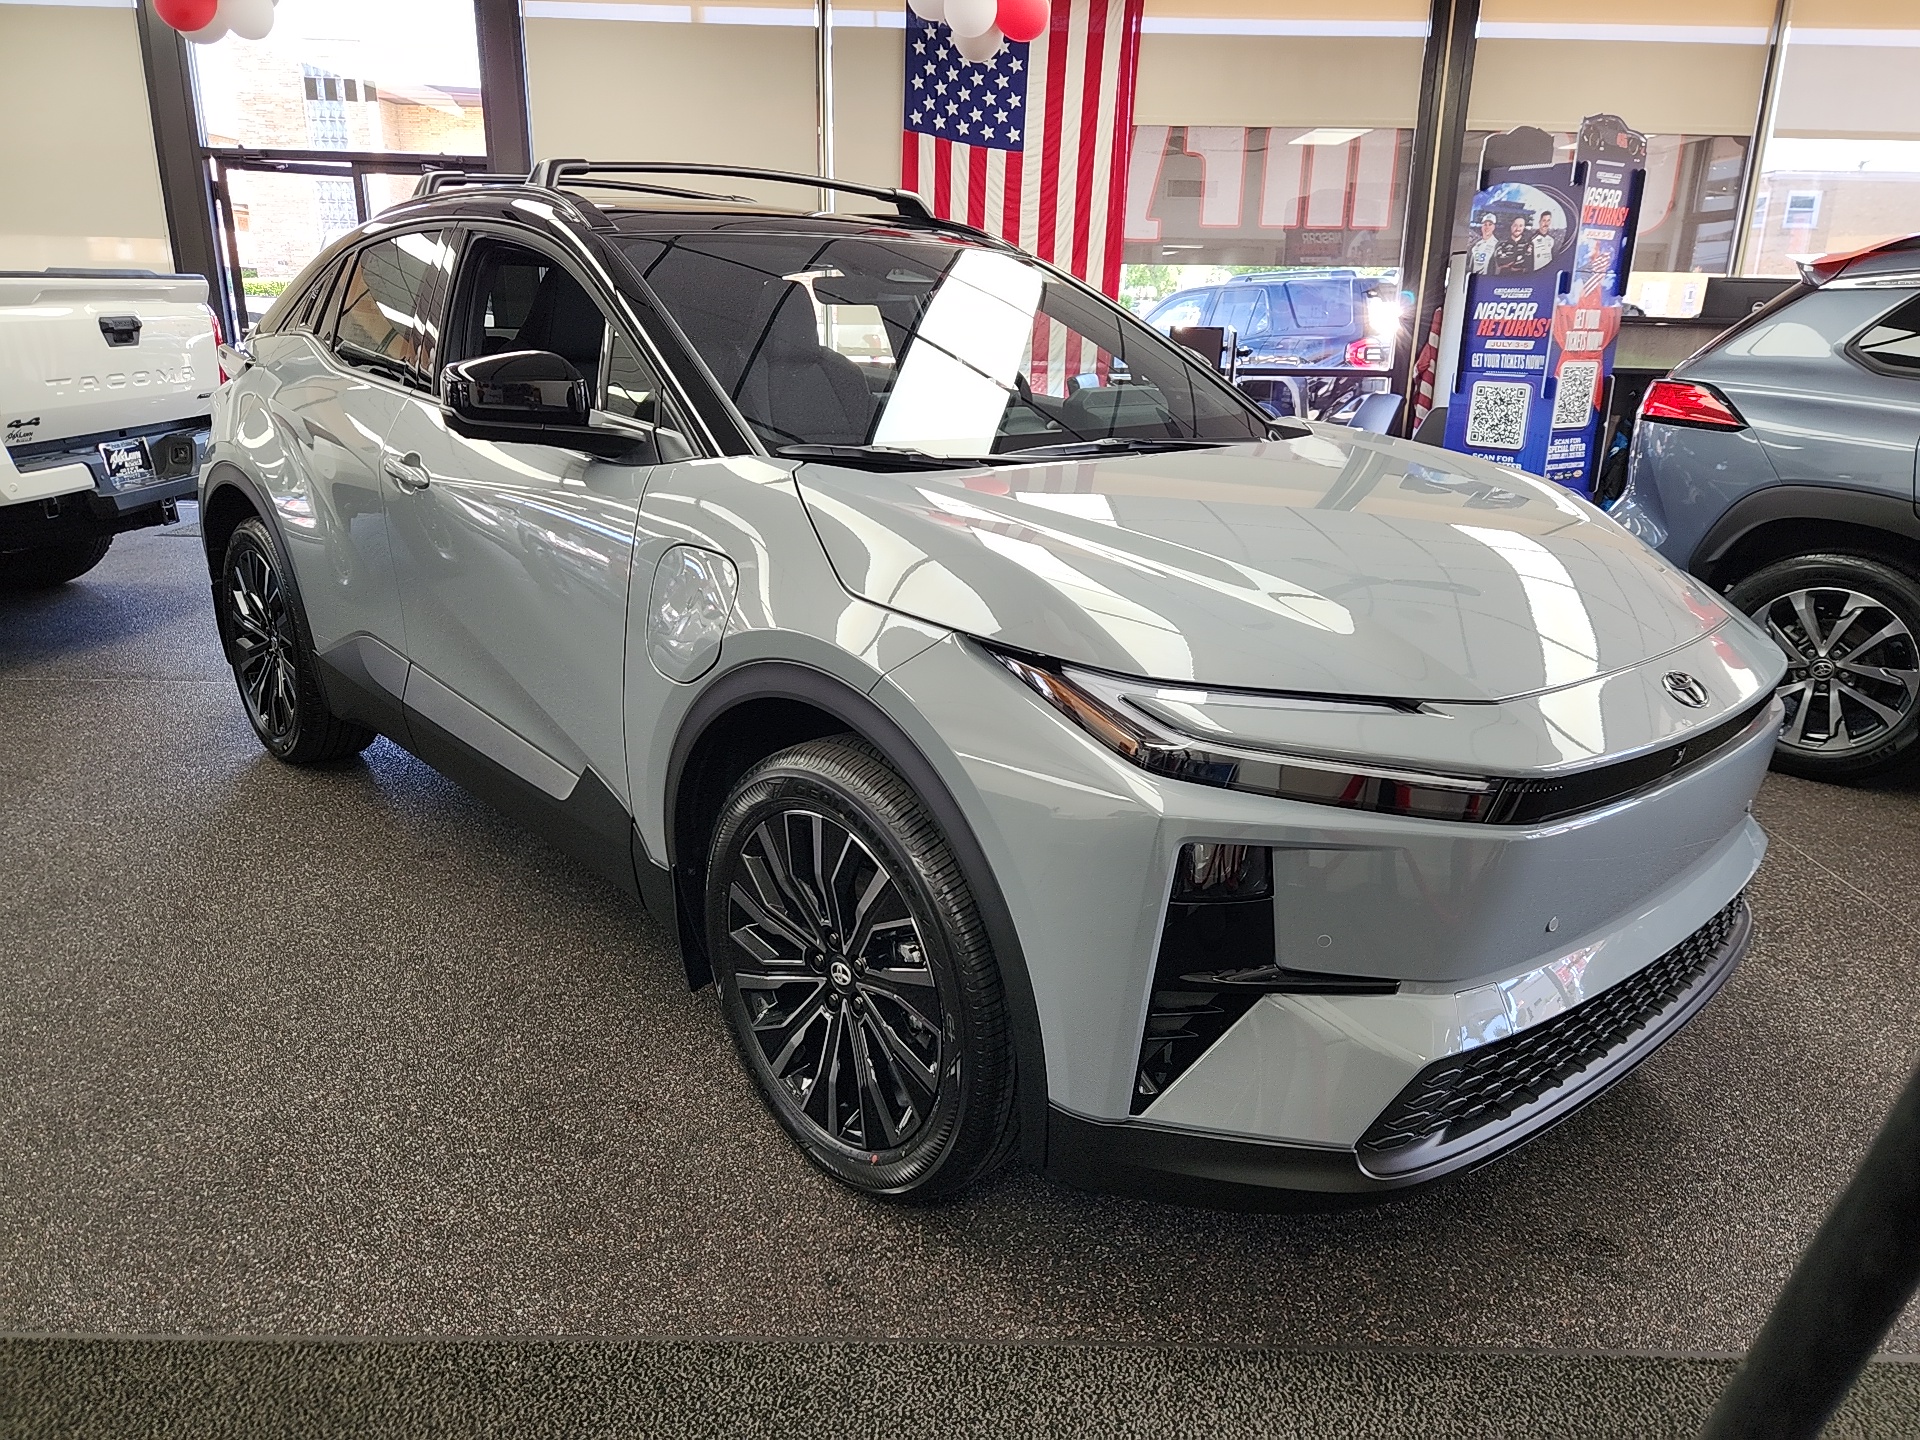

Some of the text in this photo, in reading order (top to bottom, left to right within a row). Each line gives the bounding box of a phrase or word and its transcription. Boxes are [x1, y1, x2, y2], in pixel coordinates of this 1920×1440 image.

[1473, 302, 1539, 320] NASCAR
[1476, 318, 1552, 338] RETURNS!
[1471, 353, 1484, 368] GET
[1483, 353, 1501, 368] YOUR
[1500, 354, 1526, 370] TICKETS
[45, 365, 196, 395] TACOMA
[1472, 452, 1495, 461] SCAN
